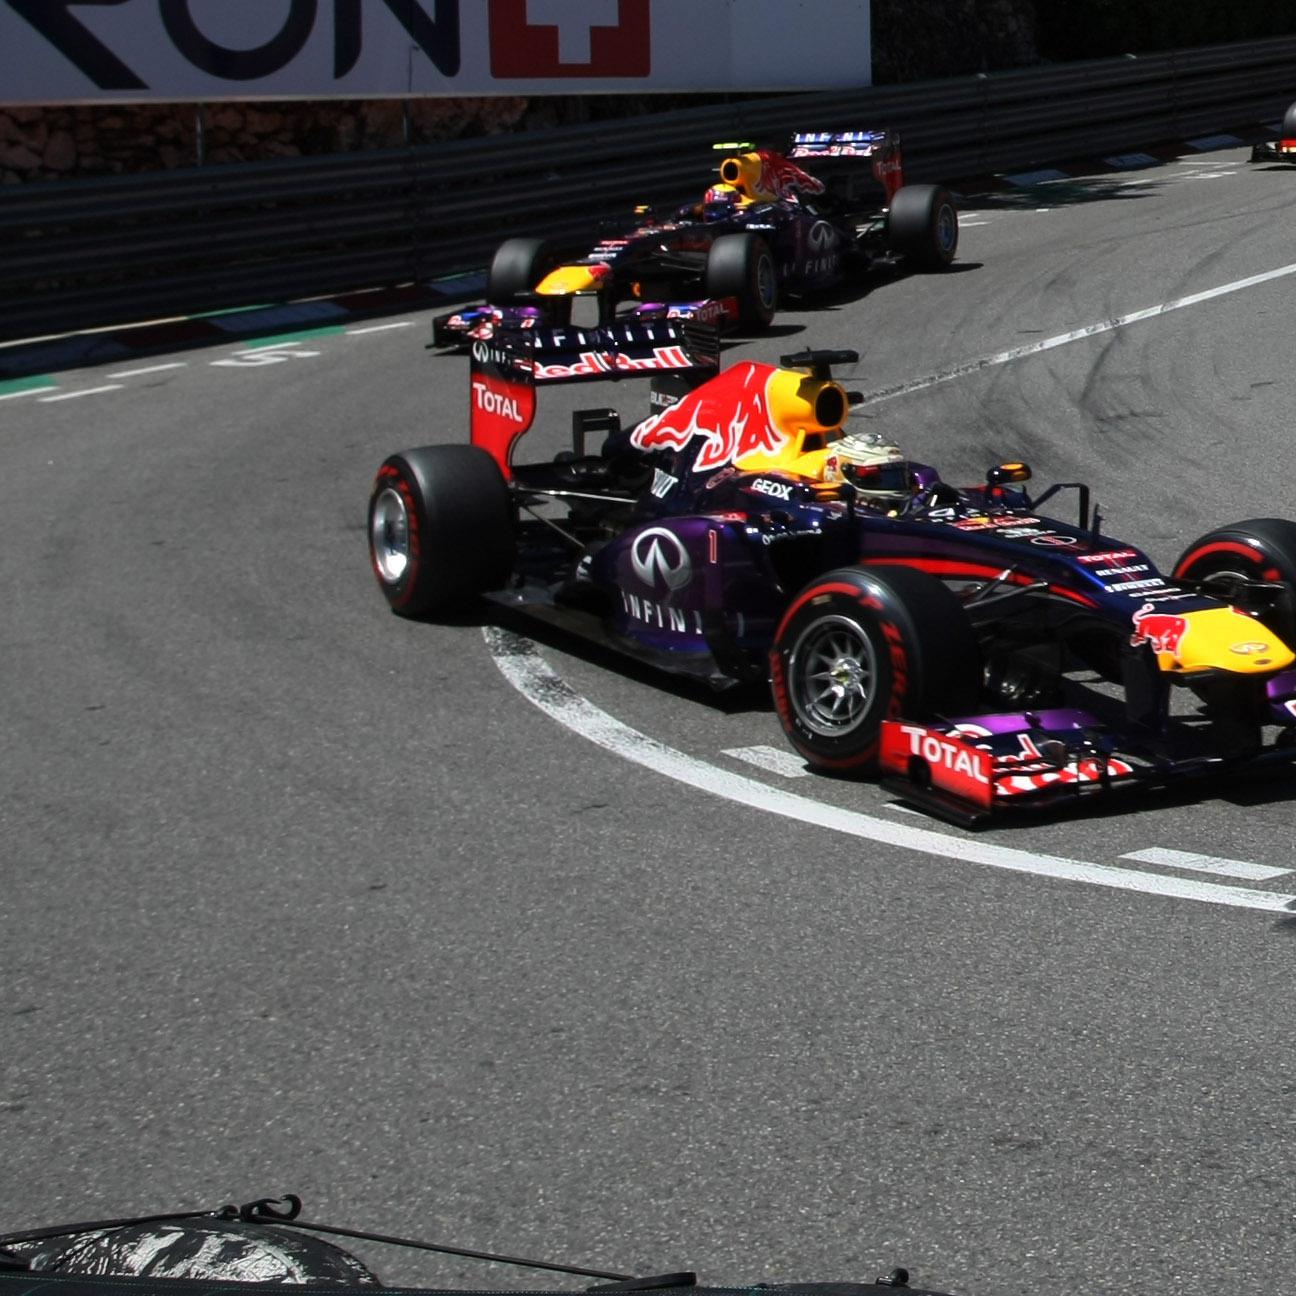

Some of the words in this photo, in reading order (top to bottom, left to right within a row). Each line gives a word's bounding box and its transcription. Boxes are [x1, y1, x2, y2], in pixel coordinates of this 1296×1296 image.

[473, 382, 523, 423] TOTAL
[752, 478, 793, 501] GEOX
[708, 529, 717, 564] 1
[1077, 551, 1137, 564] TOTAL
[900, 725, 990, 785] TOTAL
